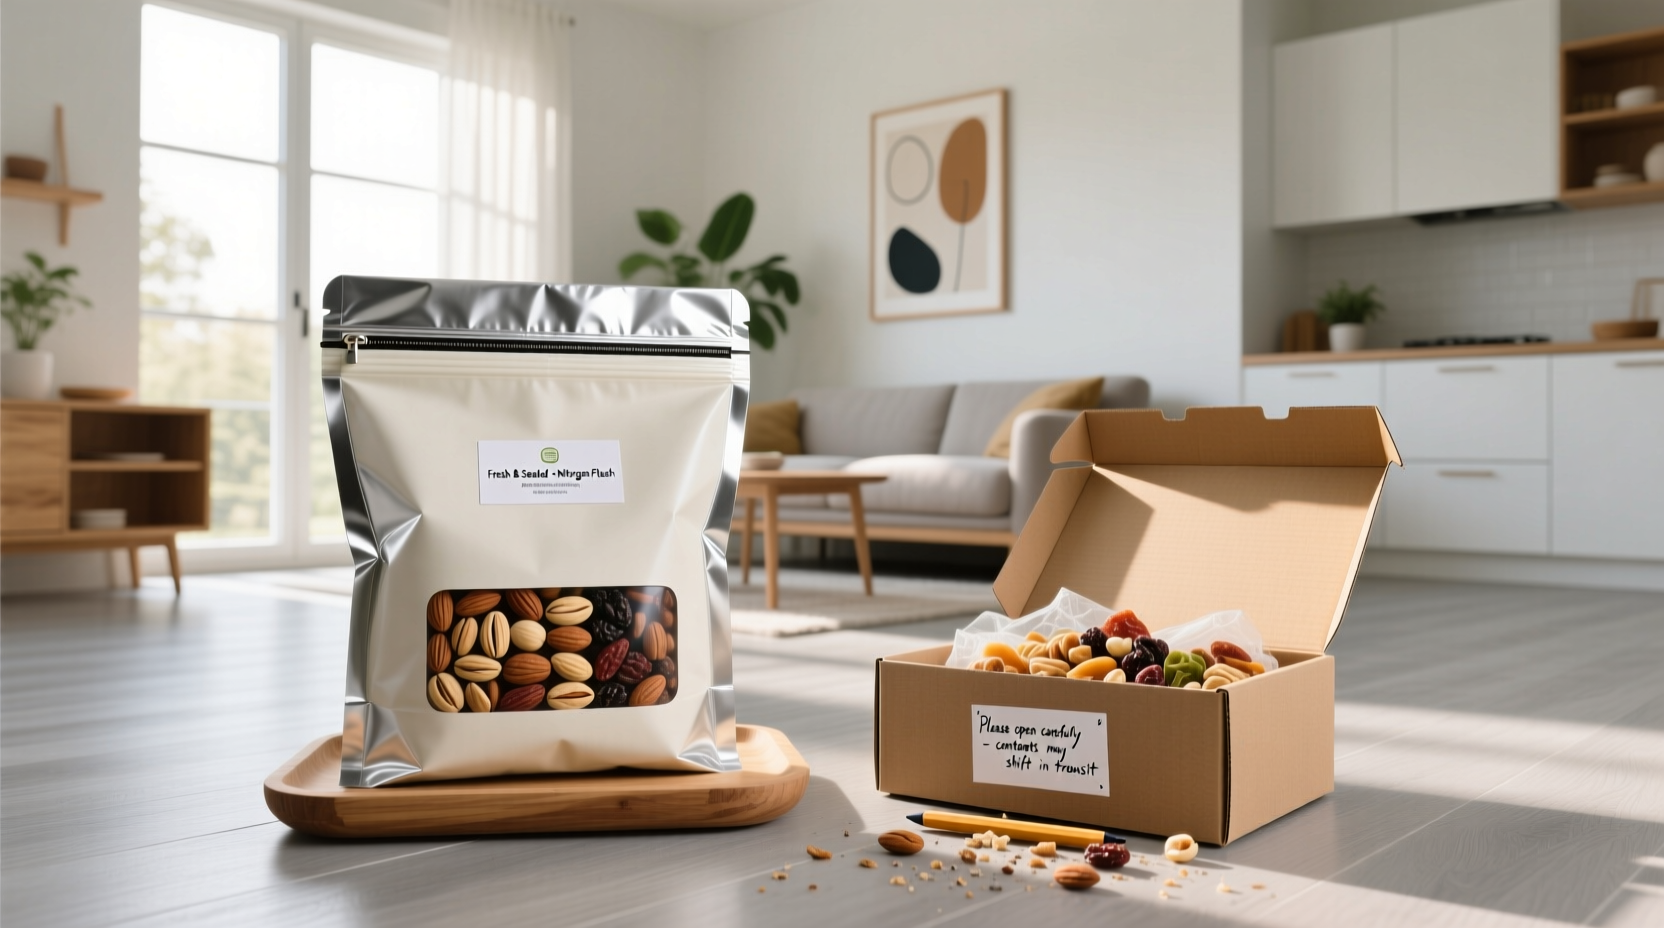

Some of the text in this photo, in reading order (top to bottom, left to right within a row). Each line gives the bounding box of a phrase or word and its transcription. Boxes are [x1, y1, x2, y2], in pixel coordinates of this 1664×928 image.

[980, 715, 1009, 733] Please
[1015, 726, 1036, 739] open
[1006, 755, 1031, 770] shift
[1040, 760, 1048, 771] in
